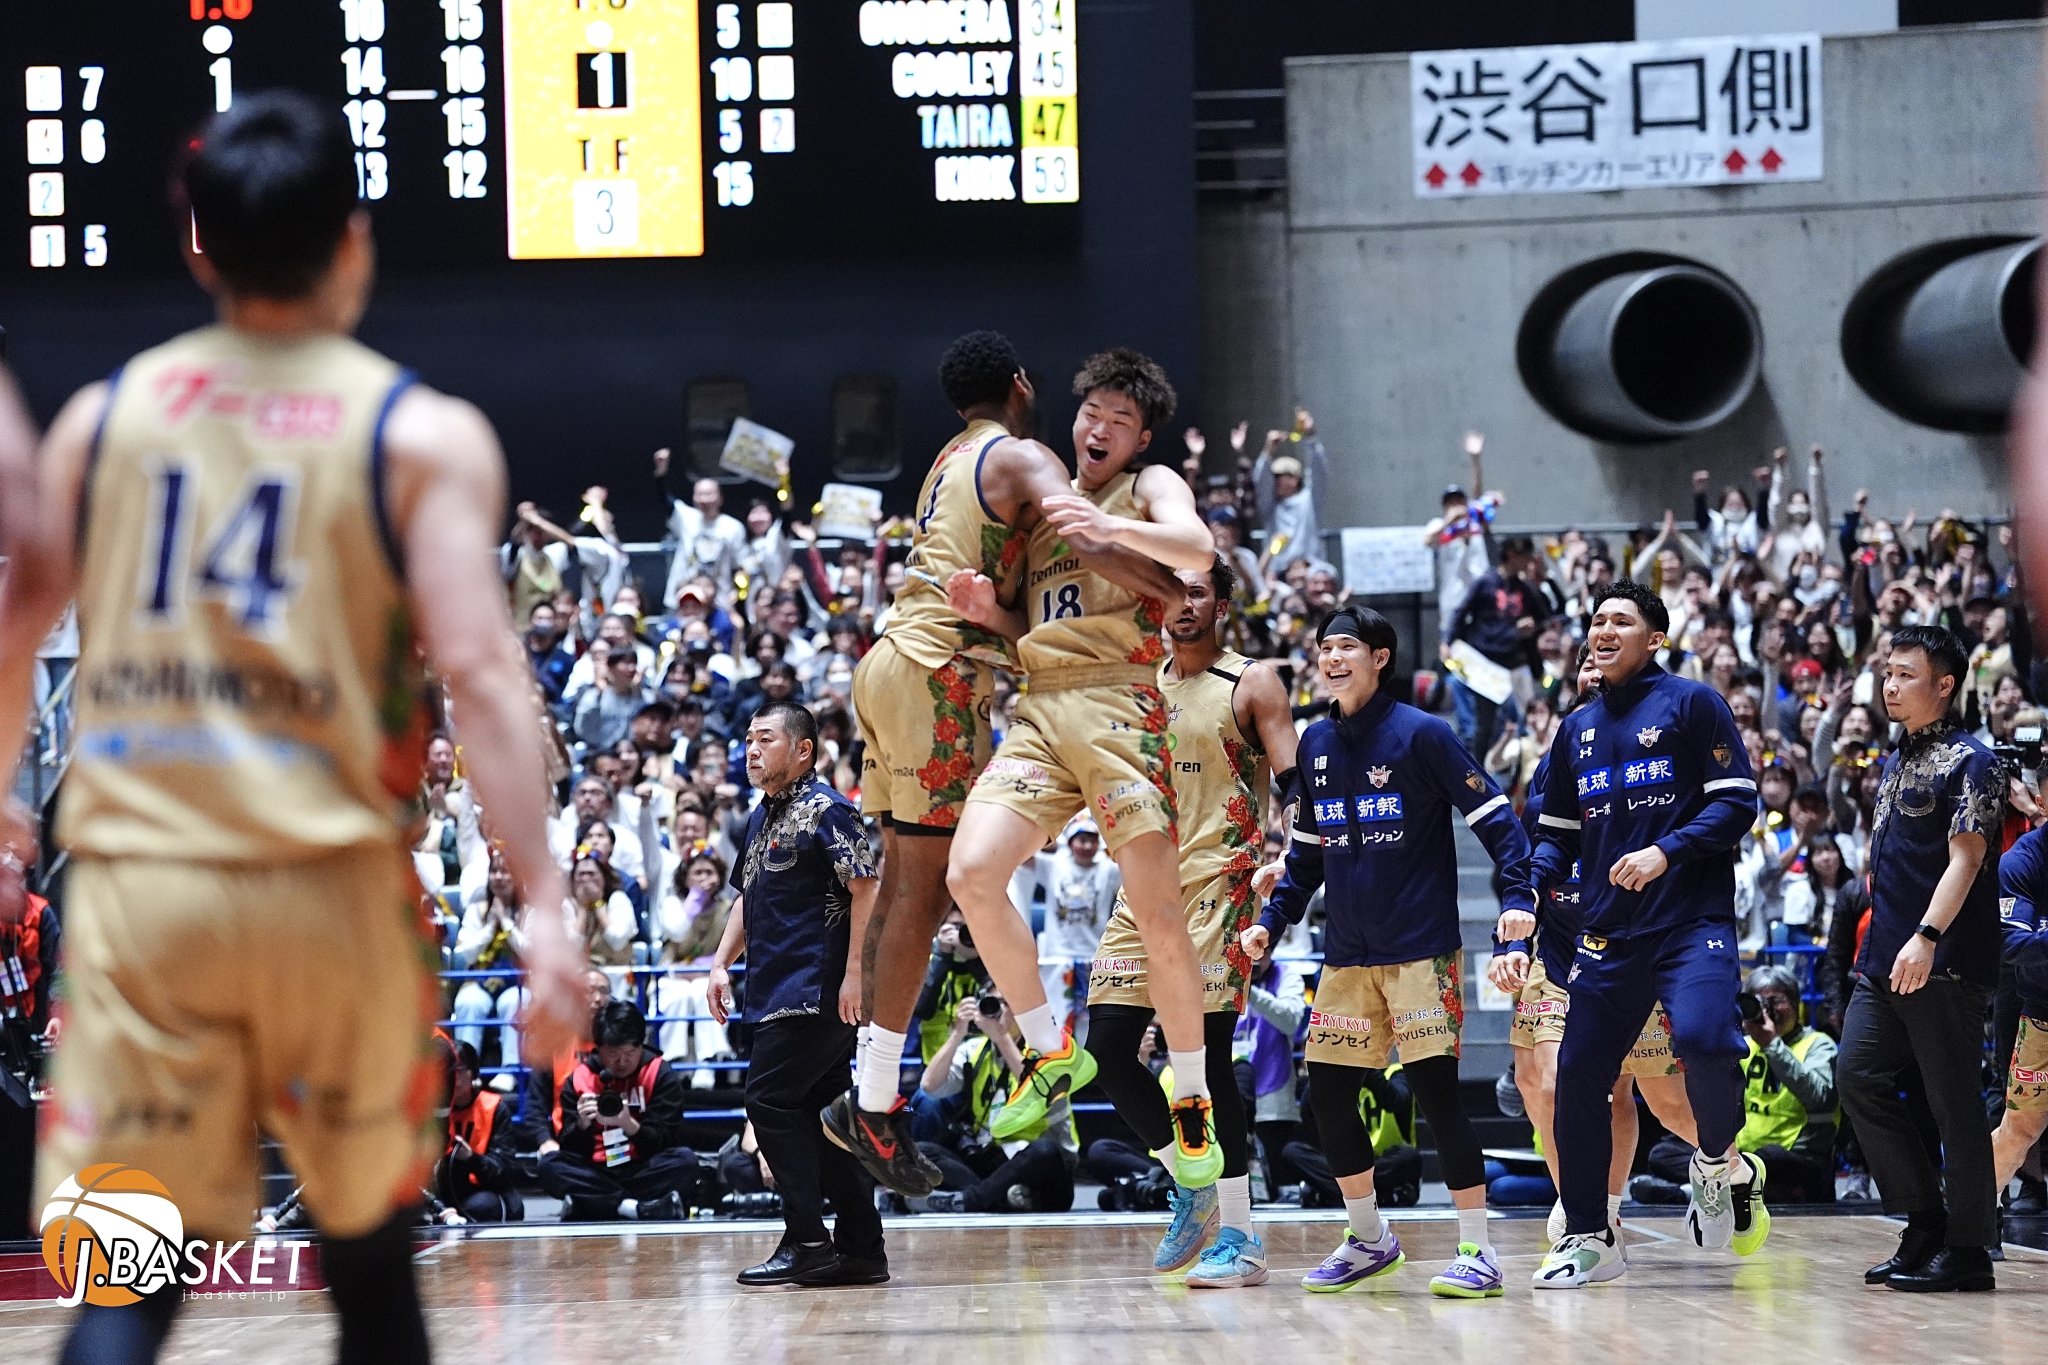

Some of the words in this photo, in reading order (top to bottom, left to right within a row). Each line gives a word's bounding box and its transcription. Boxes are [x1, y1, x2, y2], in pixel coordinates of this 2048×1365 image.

[716, 3, 741, 49] 5
[79, 66, 104, 111] 7
[208, 57, 233, 113] 1
[340, 47, 387, 95] 14
[441, 45, 486, 94] 16
[590, 51, 614, 108] 1
[710, 57, 752, 102] 10
[1032, 51, 1064, 88] 45
[1422, 45, 1811, 148] 渋谷口側
[342, 99, 387, 148] 12
[441, 97, 487, 147] 15
[719, 109, 743, 153] 5
[917, 103, 1014, 149] TAIRA
[1032, 103, 1066, 141] 47
[443, 150, 487, 199] 12
[713, 161, 754, 206] 15
[1034, 156, 1067, 193] 53
[1490, 150, 1715, 189] キッチンカーエリア
[84, 224, 108, 266] 5
[146, 464, 297, 634] 14
[1042, 583, 1083, 622] 18
[982, 775, 1043, 799] ナンセイ
[1317, 1031, 1371, 1049] ナンセイ
[1322, 1013, 1371, 1032] RYUKYU
